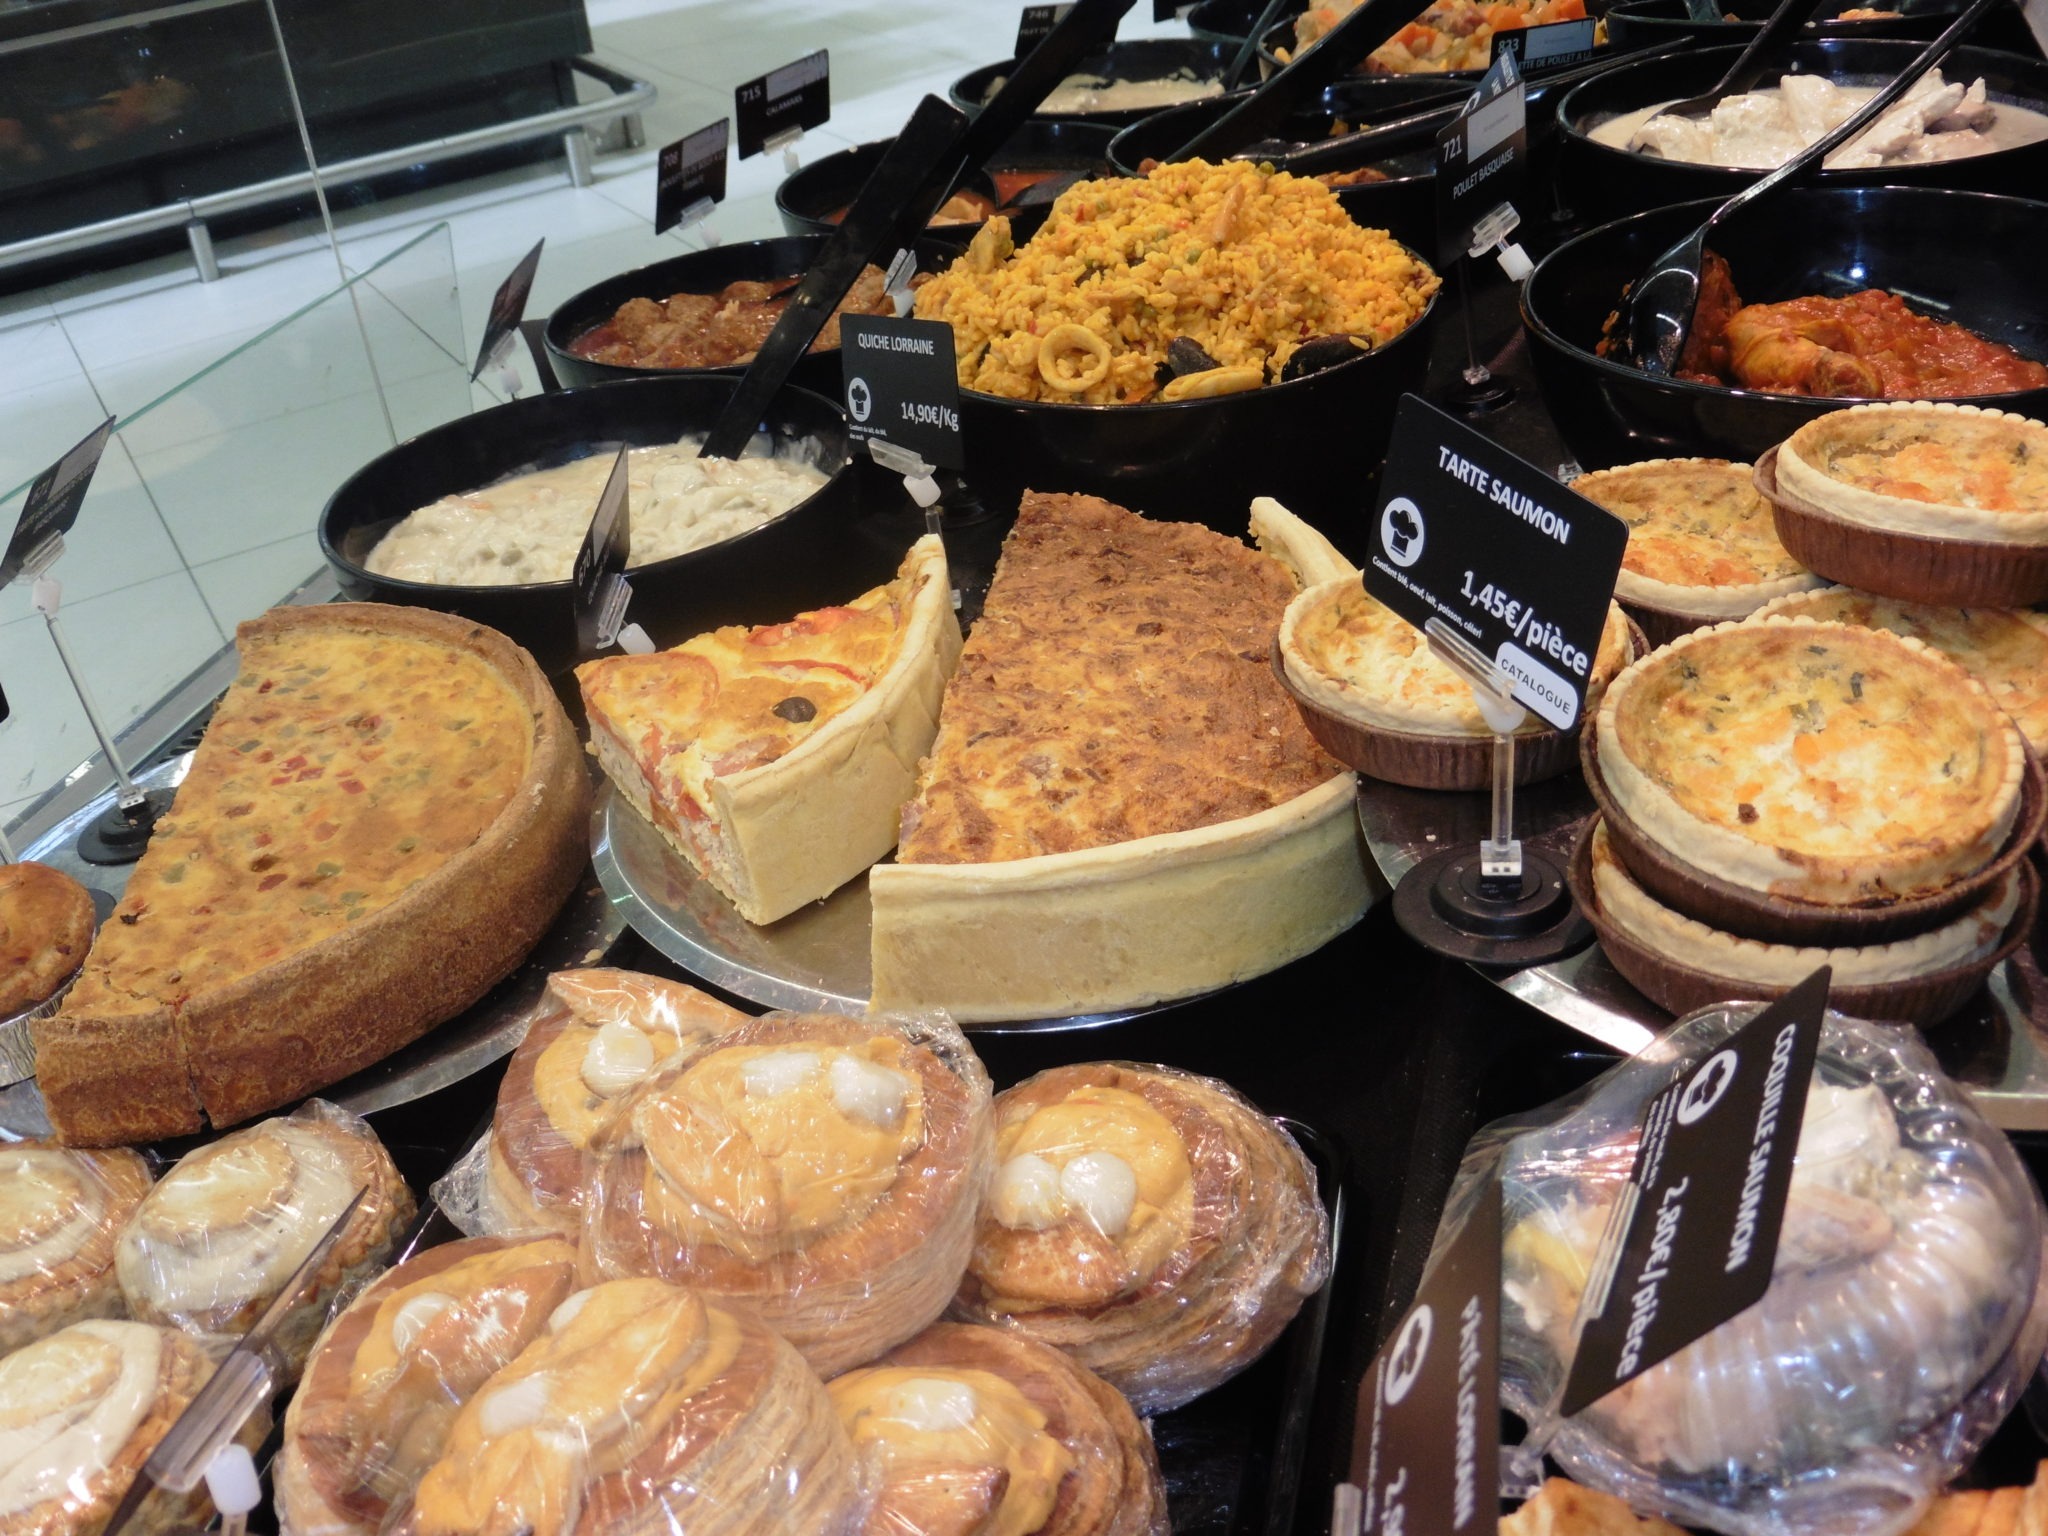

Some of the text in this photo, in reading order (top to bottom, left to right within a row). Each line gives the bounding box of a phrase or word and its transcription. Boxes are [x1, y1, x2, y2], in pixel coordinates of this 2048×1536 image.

[1547, 53, 1574, 67] POULET
[1443, 134, 1462, 163] 721
[1453, 147, 1515, 200] POULET BASQUAISE
[857, 332, 935, 356] QUICHE LORRAINE
[901, 401, 960, 433] 14,90€/Kg
[1438, 445, 1571, 545] TARTE SAUMON
[1371, 555, 1398, 579] Contient
[1459, 569, 1589, 677] 1,45€/pièce
[1500, 658, 1571, 715] CATALOGUE
[1724, 1022, 1796, 1273] COQUILLE SAUMON
[1615, 1175, 1689, 1380] 2,80€/pièce
[1453, 1376, 1476, 1531] LORRAIN
